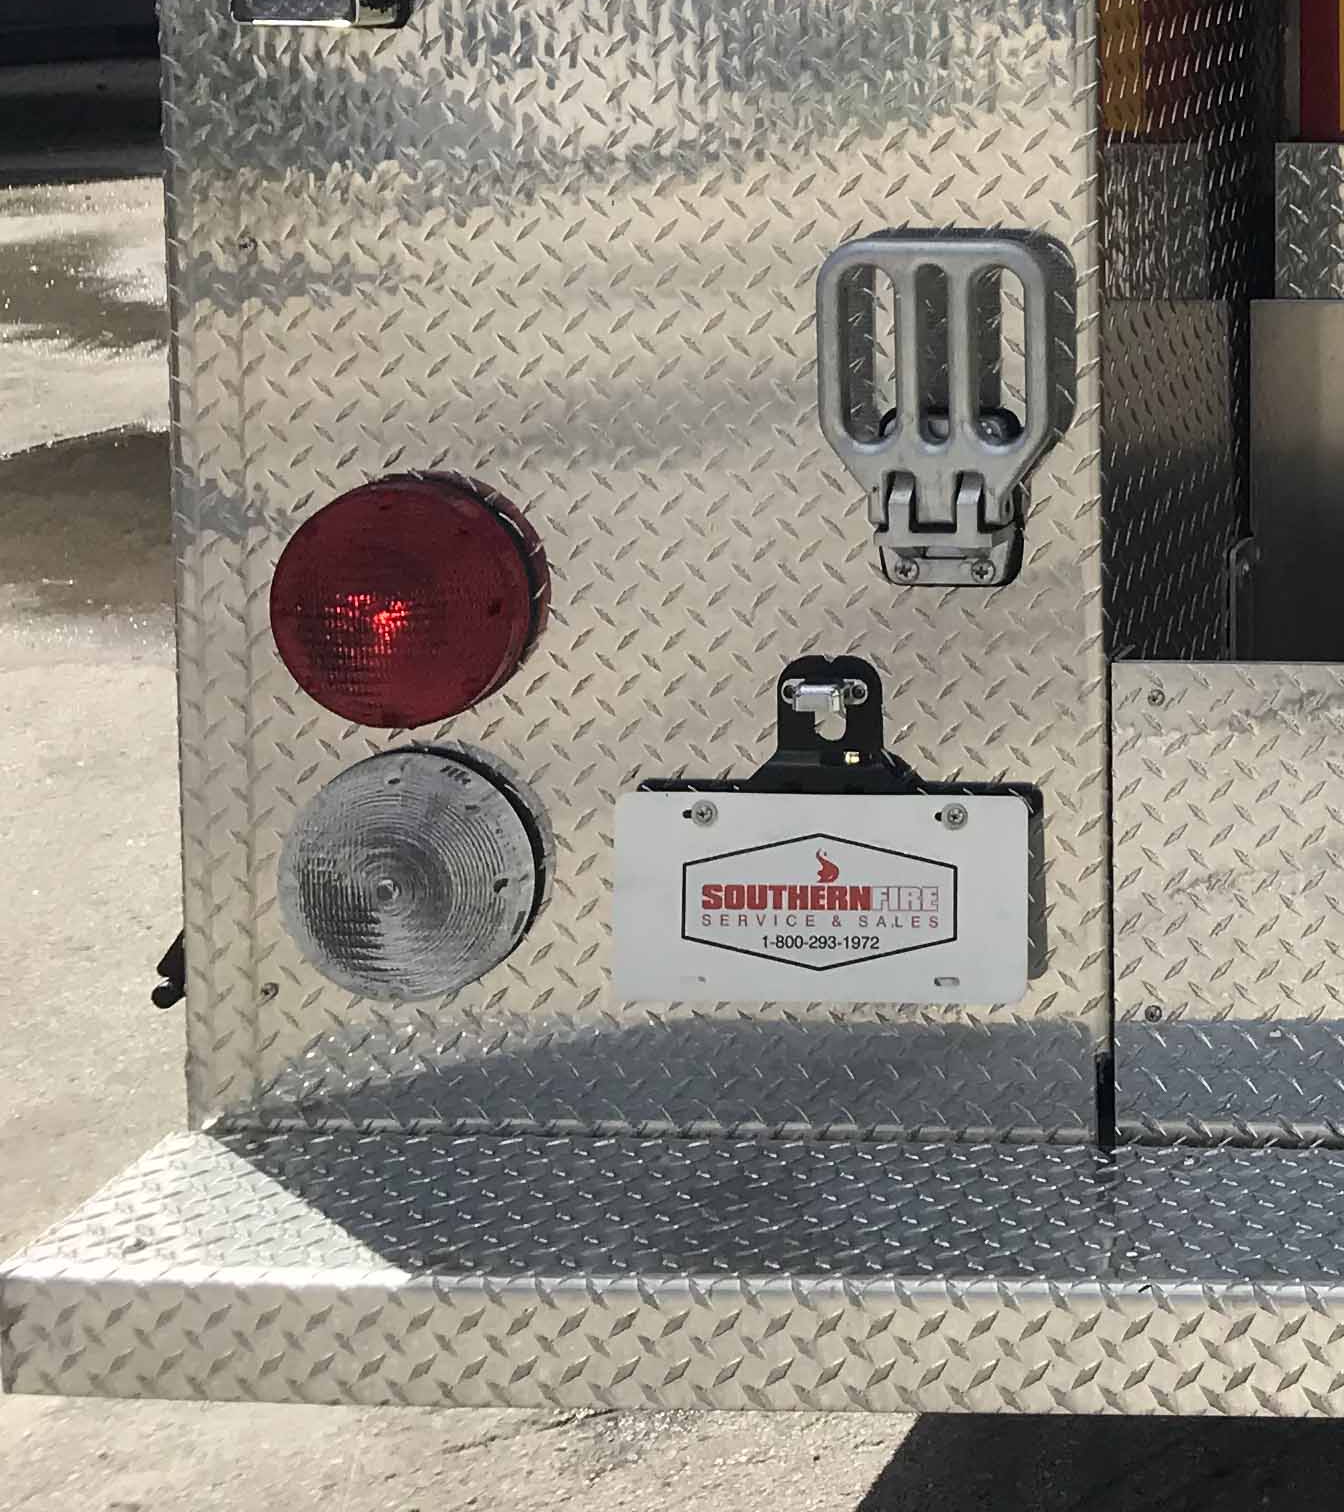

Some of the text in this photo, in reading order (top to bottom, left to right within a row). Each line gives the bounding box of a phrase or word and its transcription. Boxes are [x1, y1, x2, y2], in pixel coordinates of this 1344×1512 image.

[701, 914, 939, 929] SERVICE & SALES
[762, 935, 881, 950] 1-800-293-1972
